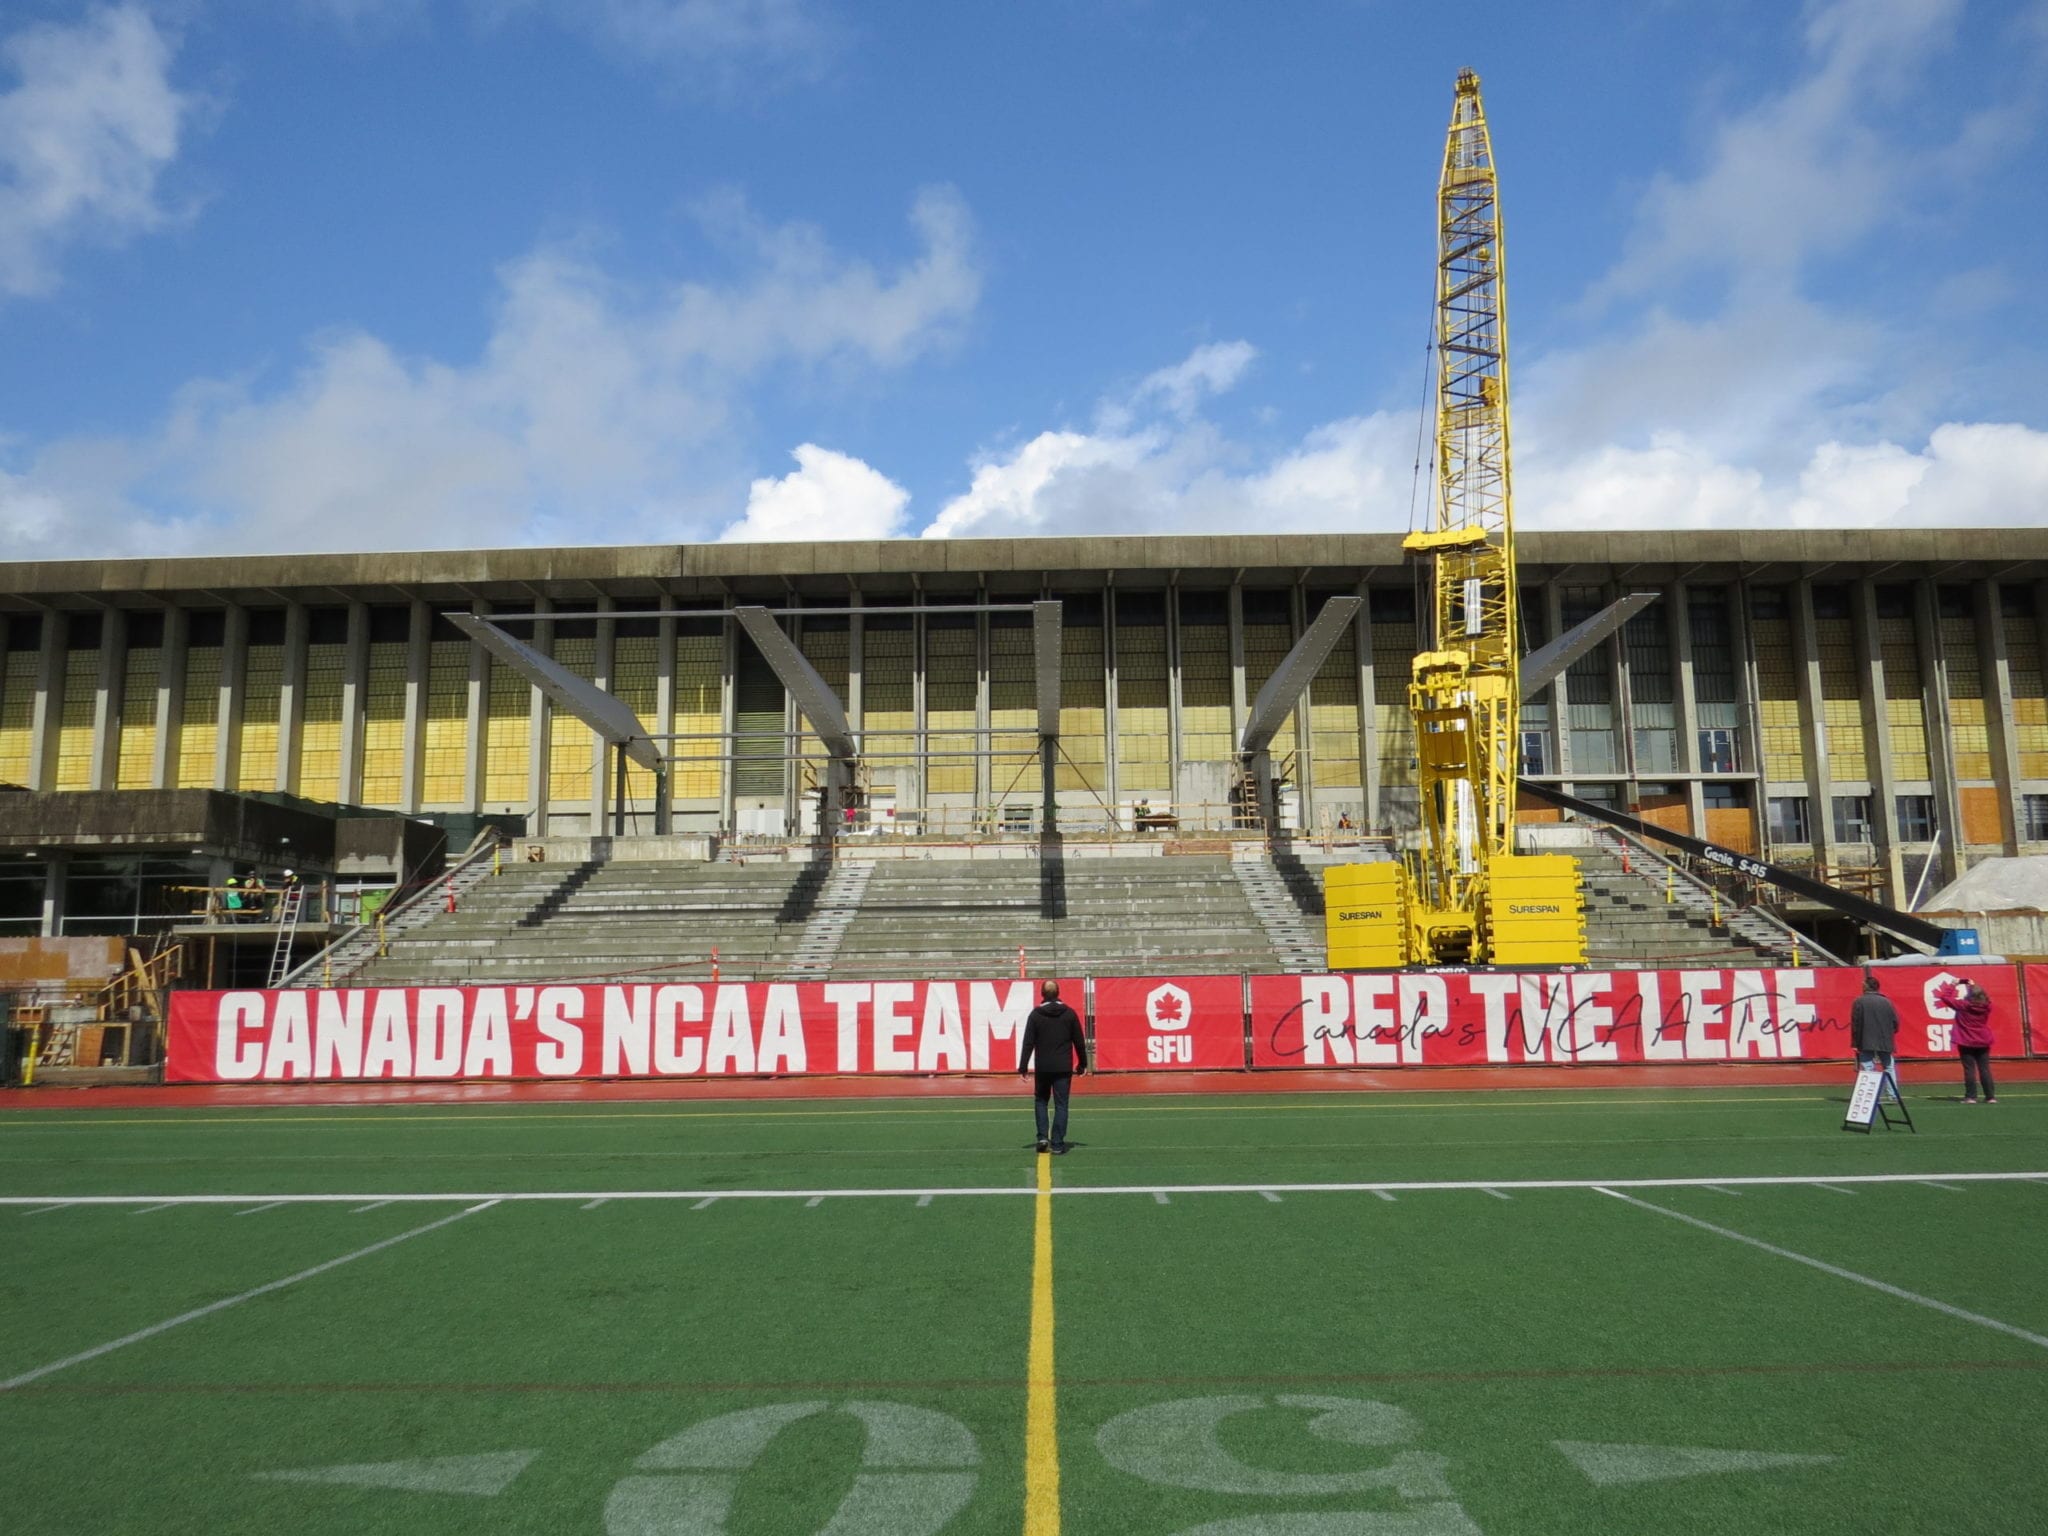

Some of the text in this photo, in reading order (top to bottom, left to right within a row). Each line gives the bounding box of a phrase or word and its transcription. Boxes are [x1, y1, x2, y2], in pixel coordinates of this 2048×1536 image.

[1704, 846, 1768, 878] Genie S-85
[1339, 911, 1382, 921] SURESPAN
[1509, 904, 1560, 914] SURESPAN
[215, 981, 1035, 1080] CANADA'S NCAA TEAM
[1271, 982, 1851, 1057] Canada's NCAA Team
[1300, 969, 1815, 1065] REP THE LEAF
[1147, 1035, 1192, 1064] SFU
[1926, 1024, 1953, 1052] SF
[1851, 1075, 1869, 1119] CLOSED
[1861, 1081, 1876, 1115] FIELD
